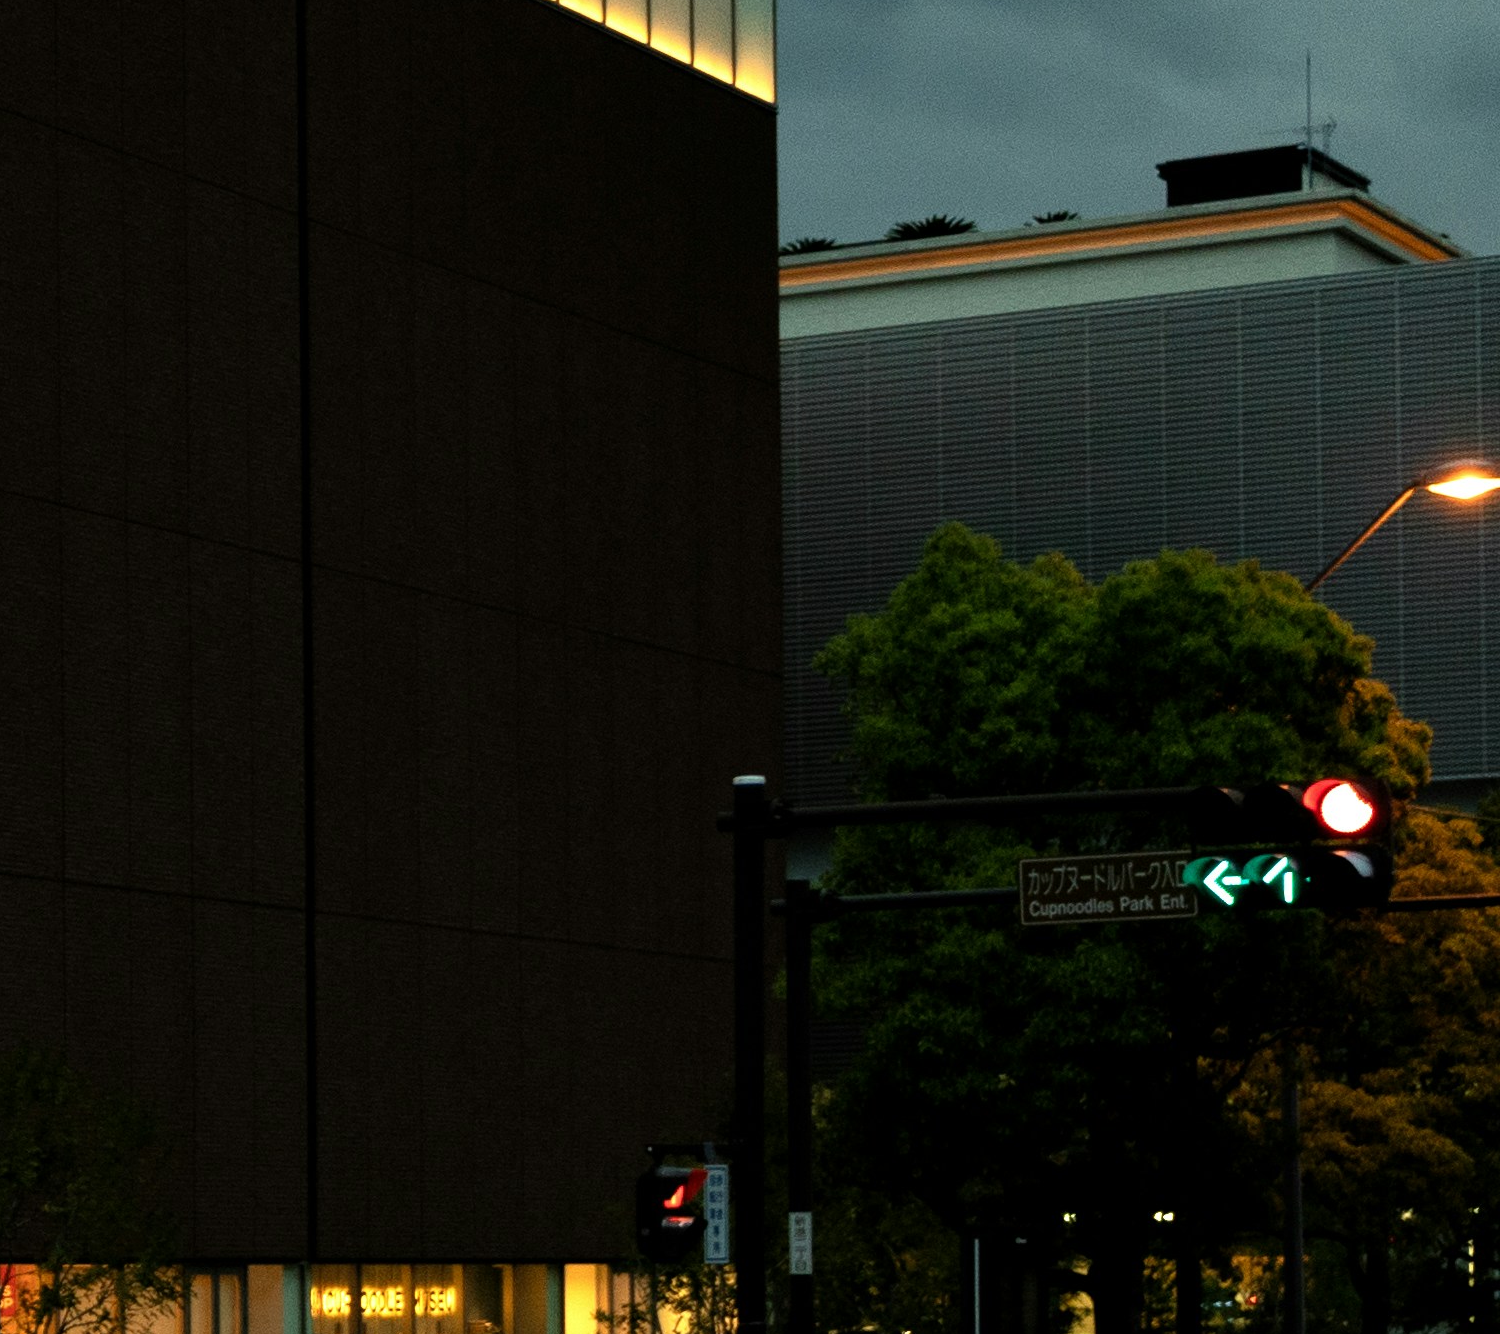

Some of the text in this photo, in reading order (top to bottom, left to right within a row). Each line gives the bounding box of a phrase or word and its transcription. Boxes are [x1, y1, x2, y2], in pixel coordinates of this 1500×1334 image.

[1029, 893, 1189, 919] Cupnoodles Park Ent.
